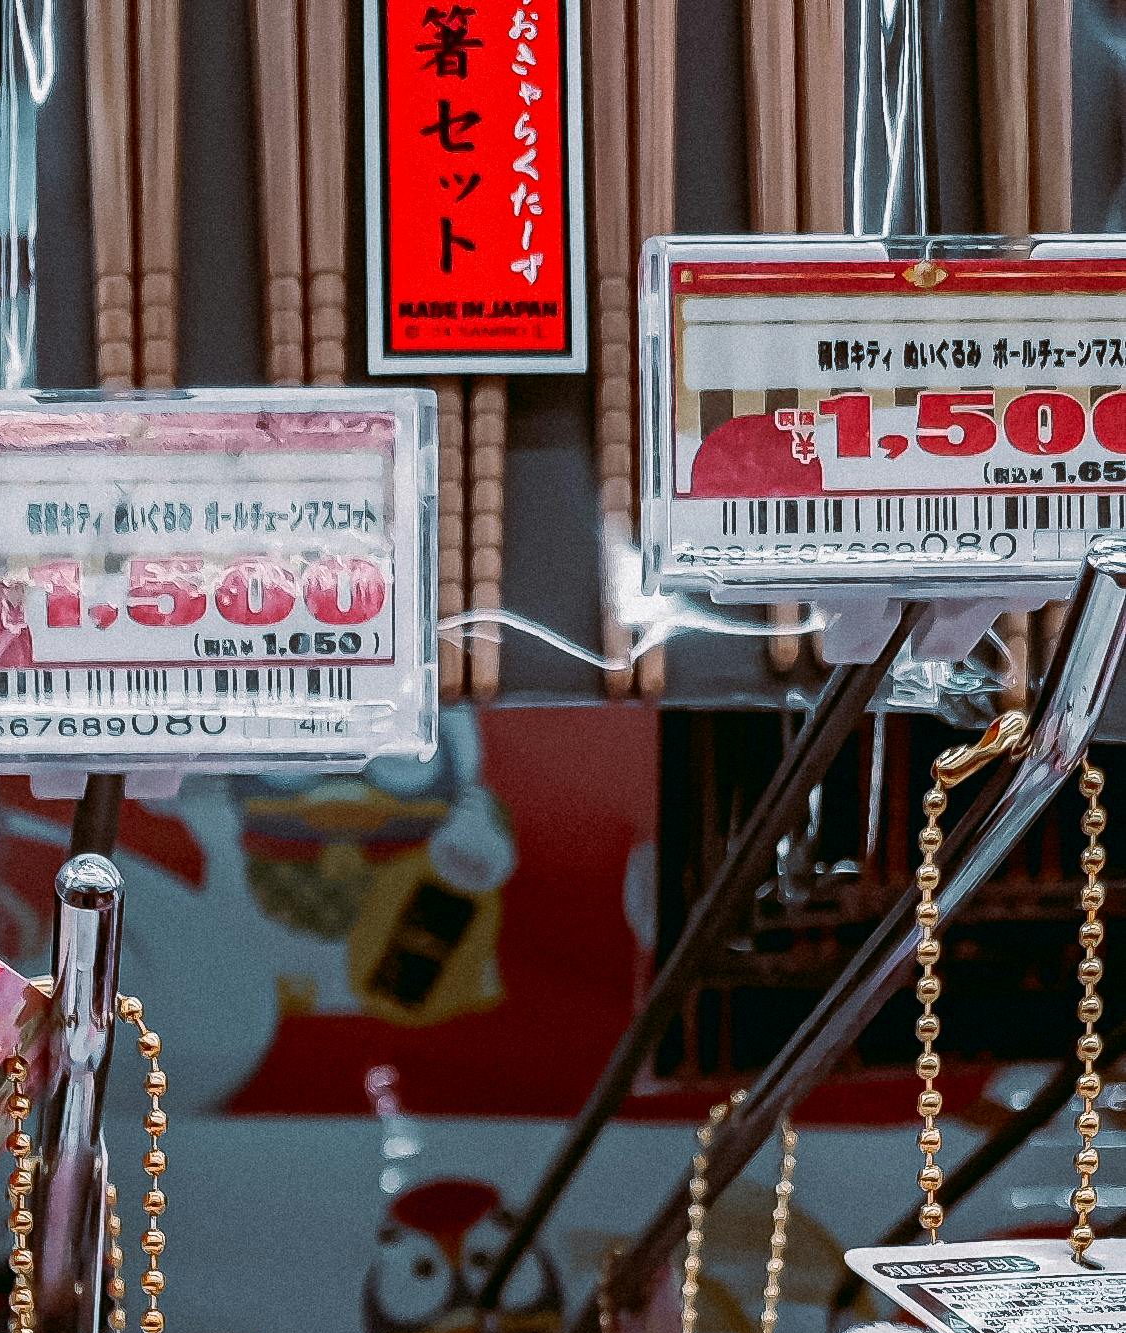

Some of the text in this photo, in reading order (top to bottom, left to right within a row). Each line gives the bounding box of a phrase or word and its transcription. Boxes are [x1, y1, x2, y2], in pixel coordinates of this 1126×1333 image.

[415, 4, 484, 275] 箸セット
[508, 0, 542, 285] おきゃらくたーず
[398, 301, 558, 319] MADE IN JAPAN
